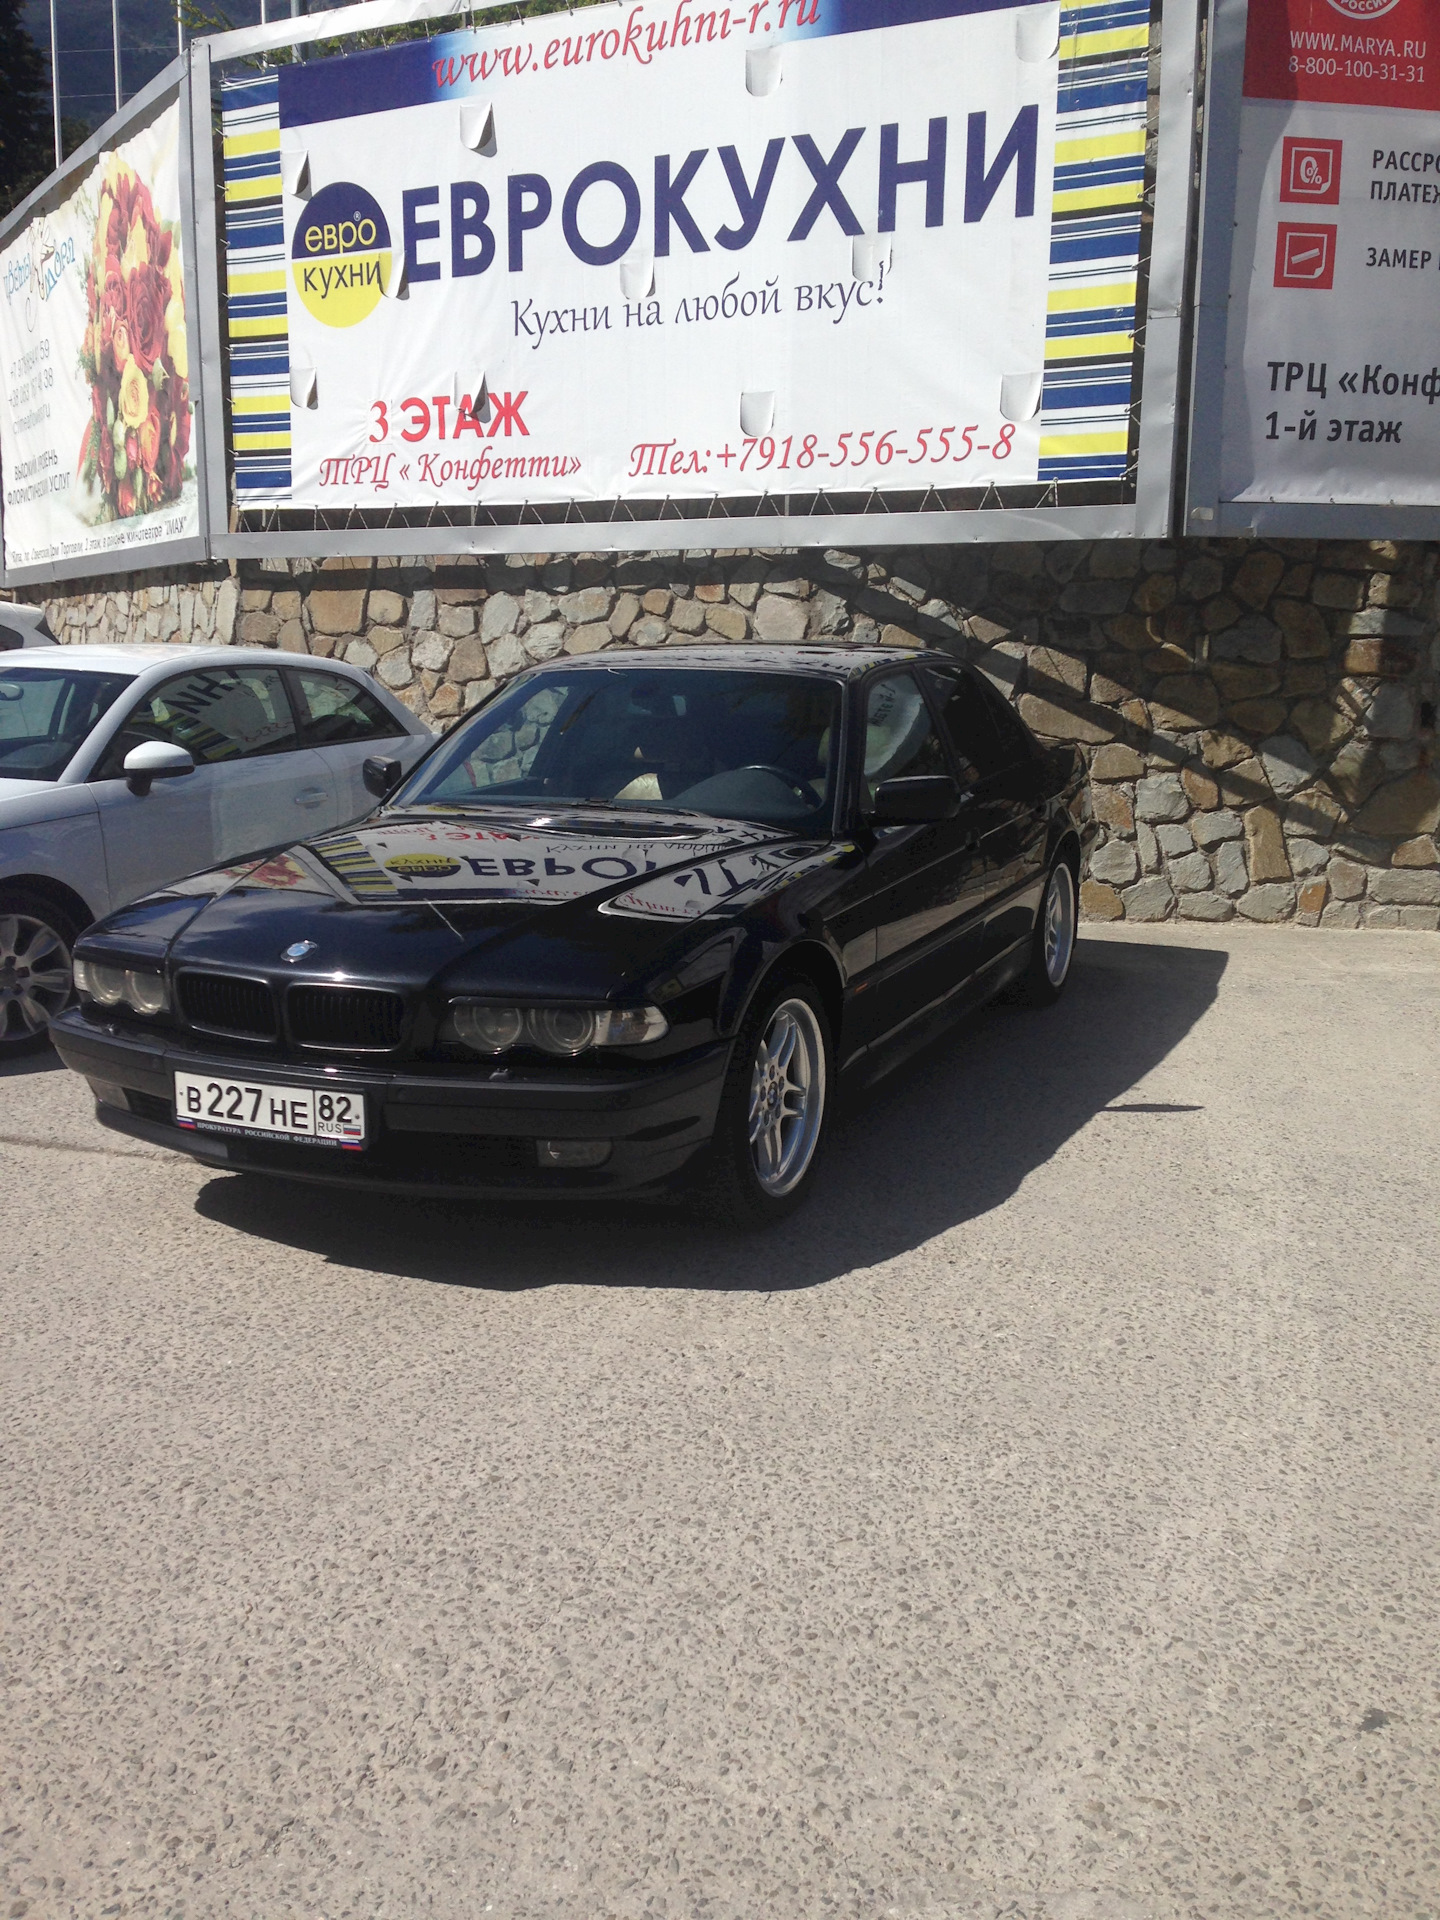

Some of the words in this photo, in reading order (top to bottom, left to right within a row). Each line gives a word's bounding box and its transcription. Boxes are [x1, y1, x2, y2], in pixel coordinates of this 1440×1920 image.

[432, 0, 821, 88] www.eurokuhni-r.ru
[1290, 30, 1426, 59] WWW.MARYA.RU
[1288, 55, 1425, 83] 8-800-100-31-31
[402, 103, 1040, 284] ЕВРОКУХНИ
[305, 218, 377, 254] евро
[1366, 247, 1432, 269] ЗАМЕР
[303, 260, 380, 299] кухни
[510, 298, 612, 349] Кухни
[624, 300, 664, 328] на
[674, 271, 782, 324] любой
[794, 260, 885, 324] вкус!
[1267, 361, 1327, 399] ТРЦ
[368, 400, 389, 443] 3
[400, 390, 530, 442] ЭТАЖ
[1266, 409, 1317, 441] 1-й
[1326, 418, 1402, 443] этаж
[48, 472, 70, 492] УСЛУГ
[318, 452, 397, 492] ТРЦ
[318, 1094, 352, 1123] 82
[196, 1122, 242, 1135] ПРОКУРАТУРА
[244, 1128, 290, 1142] РОССИЙСКОЙ
[293, 1134, 338, 1147] ФЕДЕРАЦИИ
[317, 1121, 342, 1134] RUS
